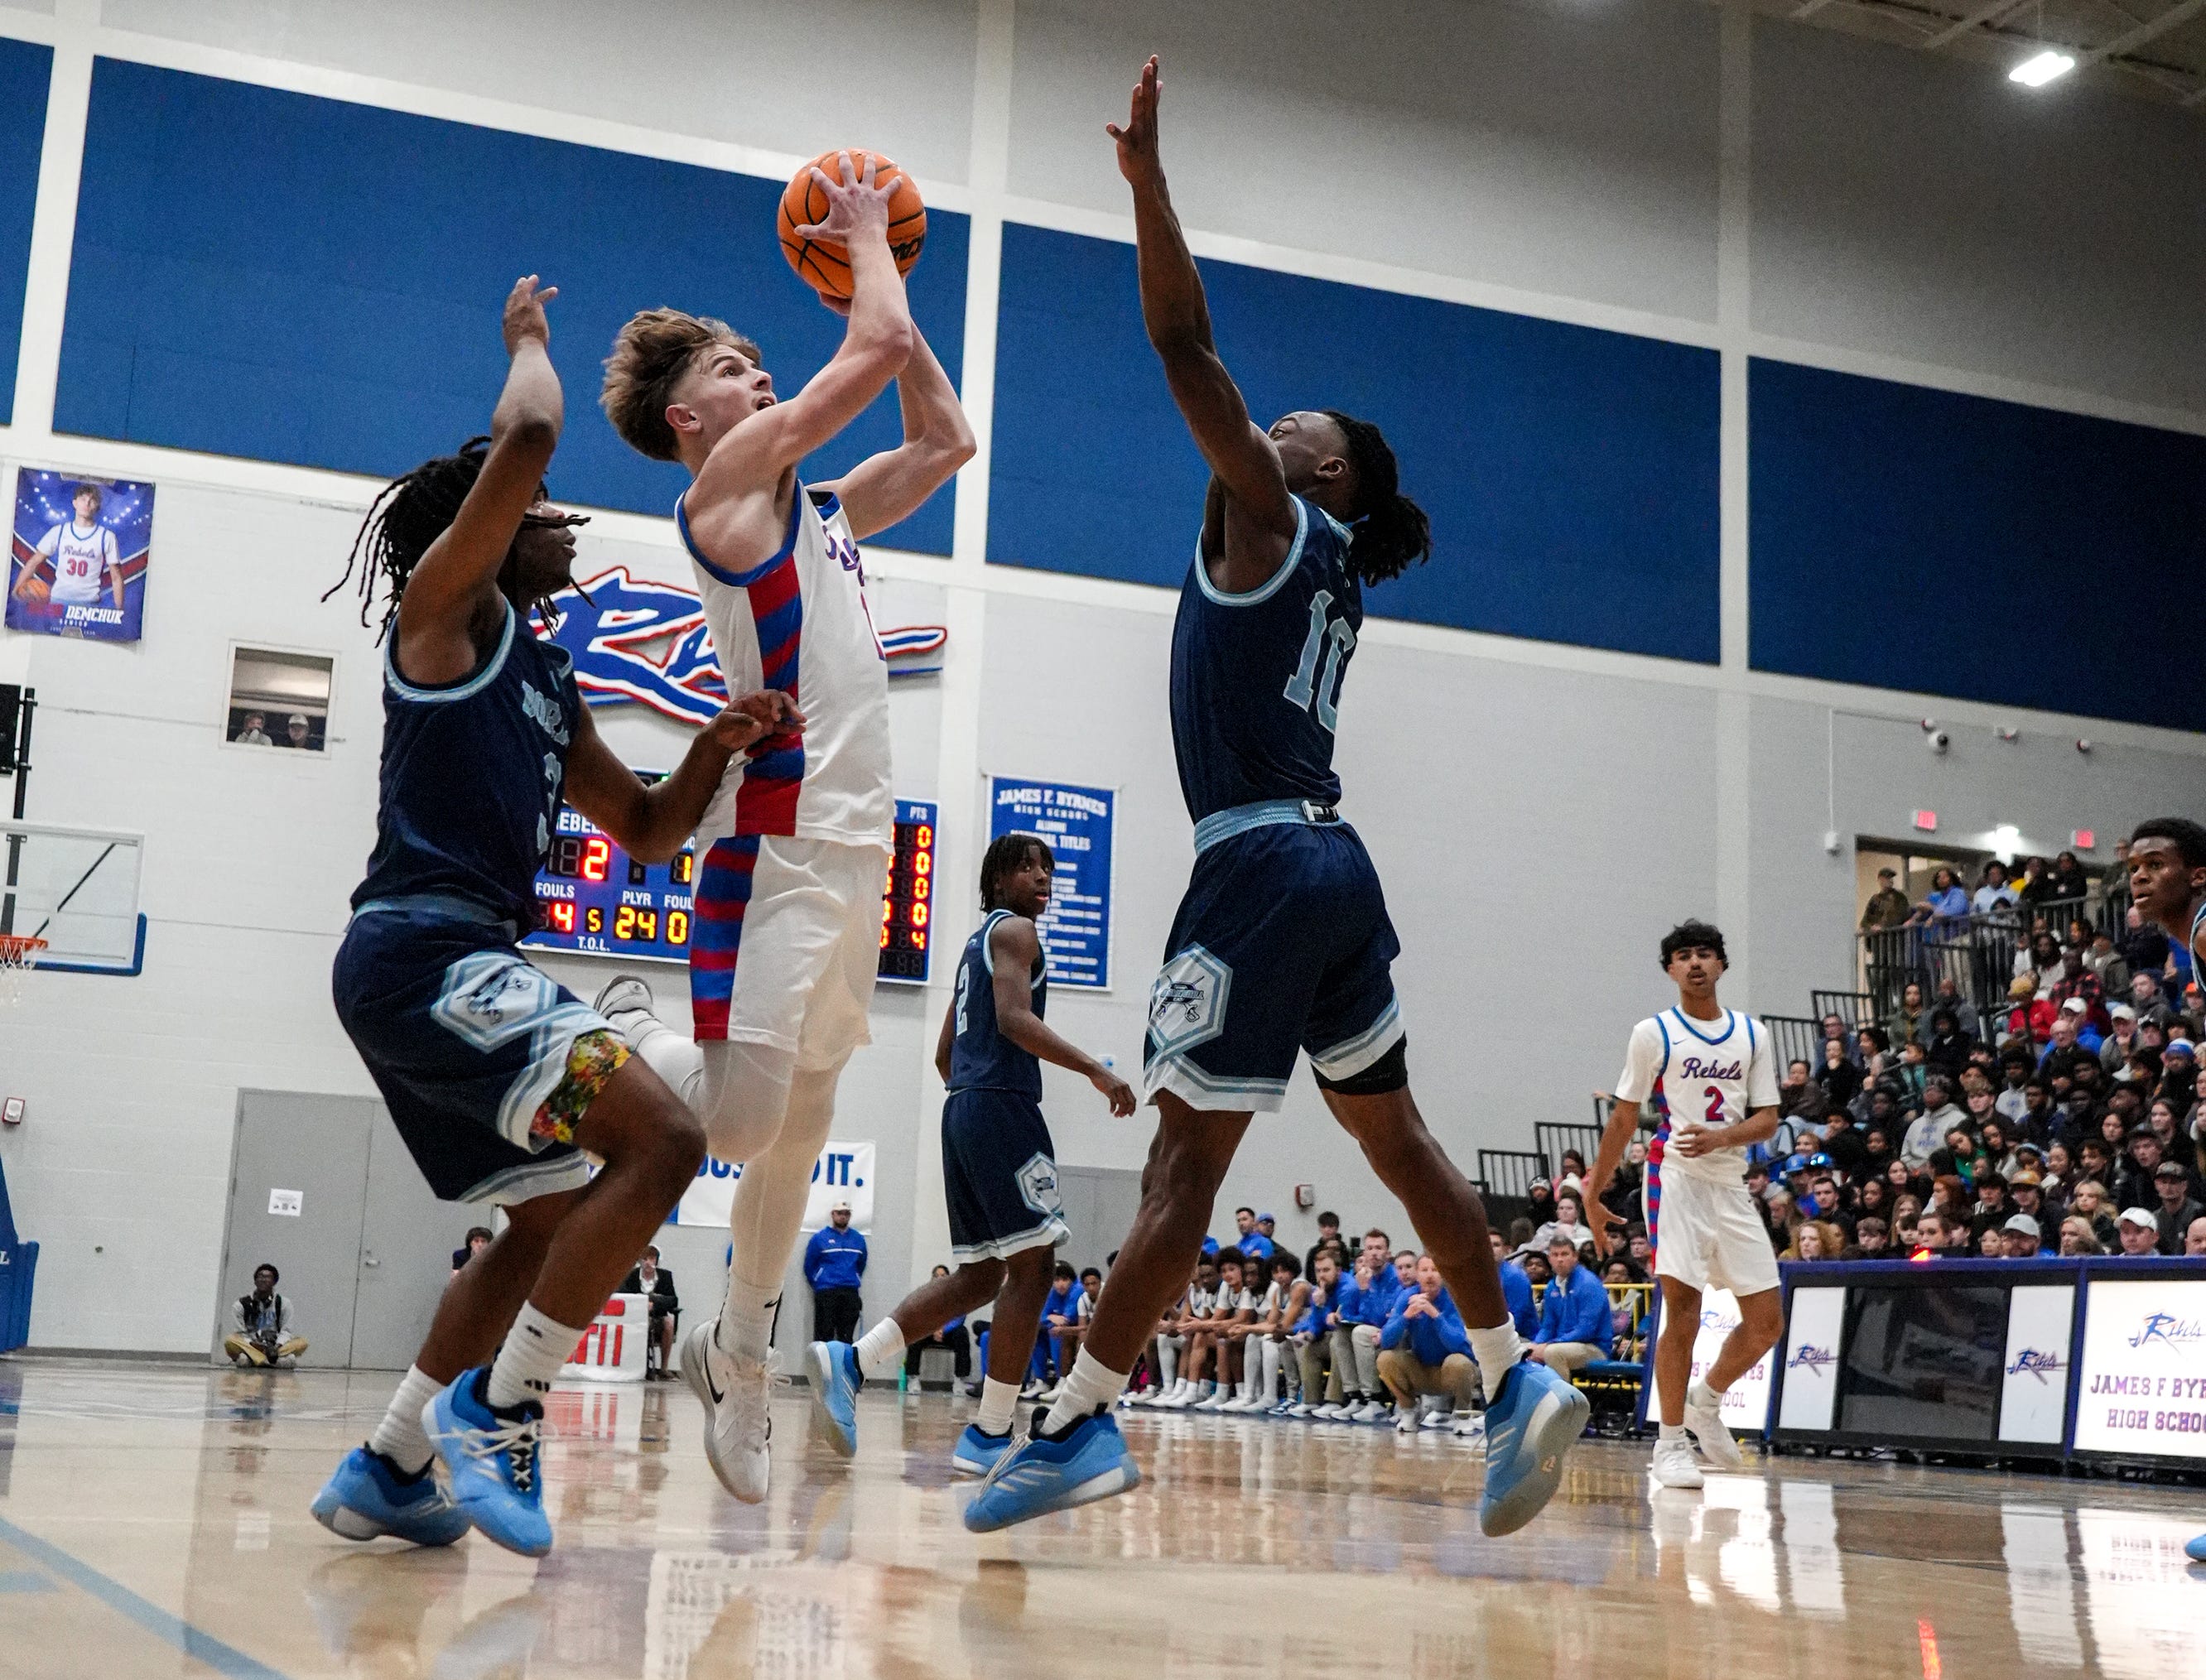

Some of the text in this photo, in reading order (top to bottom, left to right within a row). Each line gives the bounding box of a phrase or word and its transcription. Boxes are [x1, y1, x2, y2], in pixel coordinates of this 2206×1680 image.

[66, 558, 89, 577] 30
[65, 605, 124, 624] DEMCHUK
[997, 788, 1042, 805] JAMES
[918, 826, 932, 848] 0
[585, 840, 609, 880] 2
[916, 851, 931, 874] 0
[536, 883, 575, 898] FOULS
[623, 890, 652, 906] PLYR
[914, 877, 928, 899] 0
[555, 903, 573, 931] 4
[616, 907, 656, 939] 24
[913, 903, 927, 926] 0
[667, 912, 687, 944] 0
[956, 962, 970, 1037] 2
[1680, 1057, 1741, 1080] Rebels
[1704, 1086, 1724, 1122] 2
[826, 1153, 864, 1187] IT.
[2090, 1374, 2151, 1395] JAMES
[2156, 1378, 2167, 1397] F
[2107, 1408, 2149, 1429] HIGH
